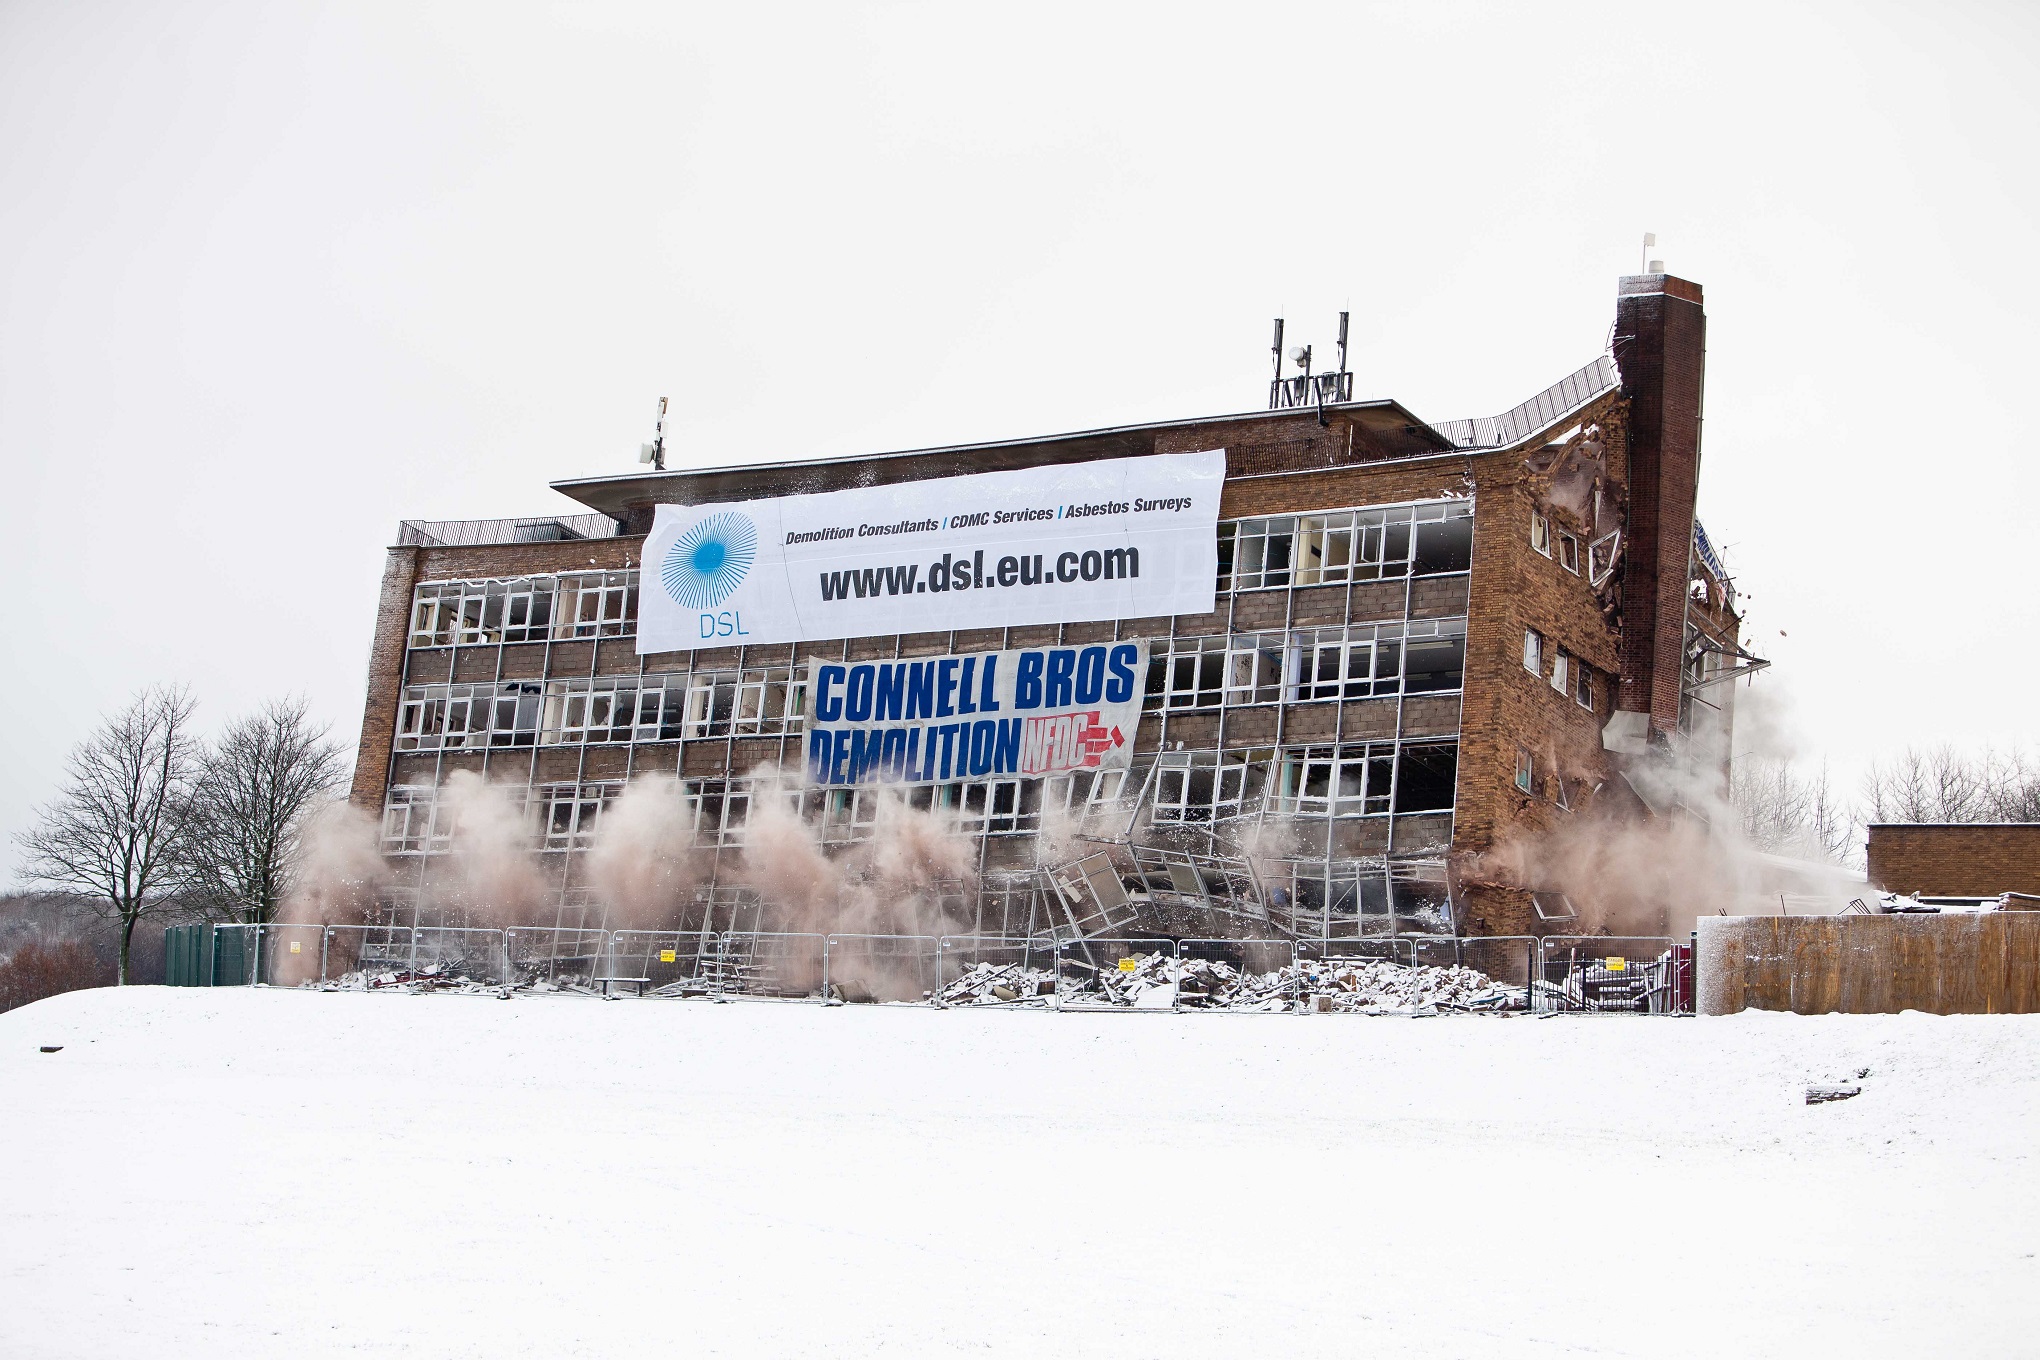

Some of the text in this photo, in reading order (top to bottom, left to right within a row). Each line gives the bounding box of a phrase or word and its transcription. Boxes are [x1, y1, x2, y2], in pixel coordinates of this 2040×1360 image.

[785, 496, 1192, 545] Demolition Consultants CDMC Services Asbestos Surveys
[819, 546, 1139, 602] www.dsl.eu.com
[699, 611, 750, 639] DSL
[814, 644, 1138, 723] CONNELL BROS
[808, 717, 1022, 785] DEMOLITION
[1022, 714, 1088, 774] NFDC
